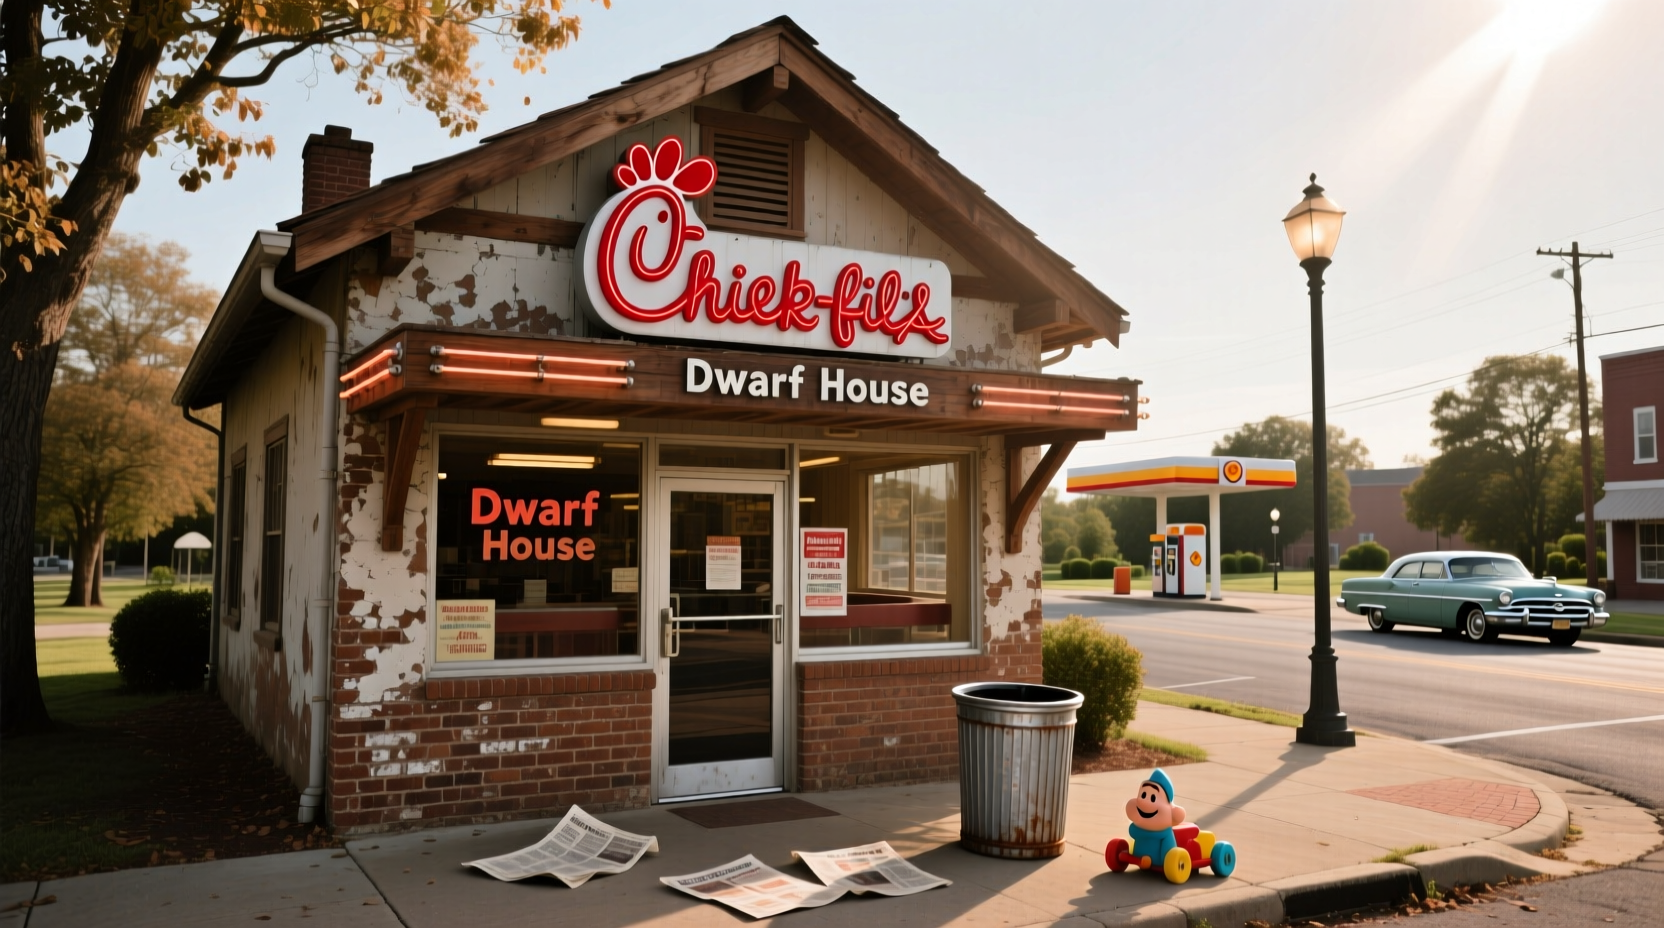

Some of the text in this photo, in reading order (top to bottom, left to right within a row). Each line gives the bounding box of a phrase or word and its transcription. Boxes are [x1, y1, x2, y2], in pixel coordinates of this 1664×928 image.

[686, 358, 929, 407] Dwarf House
[471, 487, 600, 526] Dwarf
[482, 529, 596, 561] House
